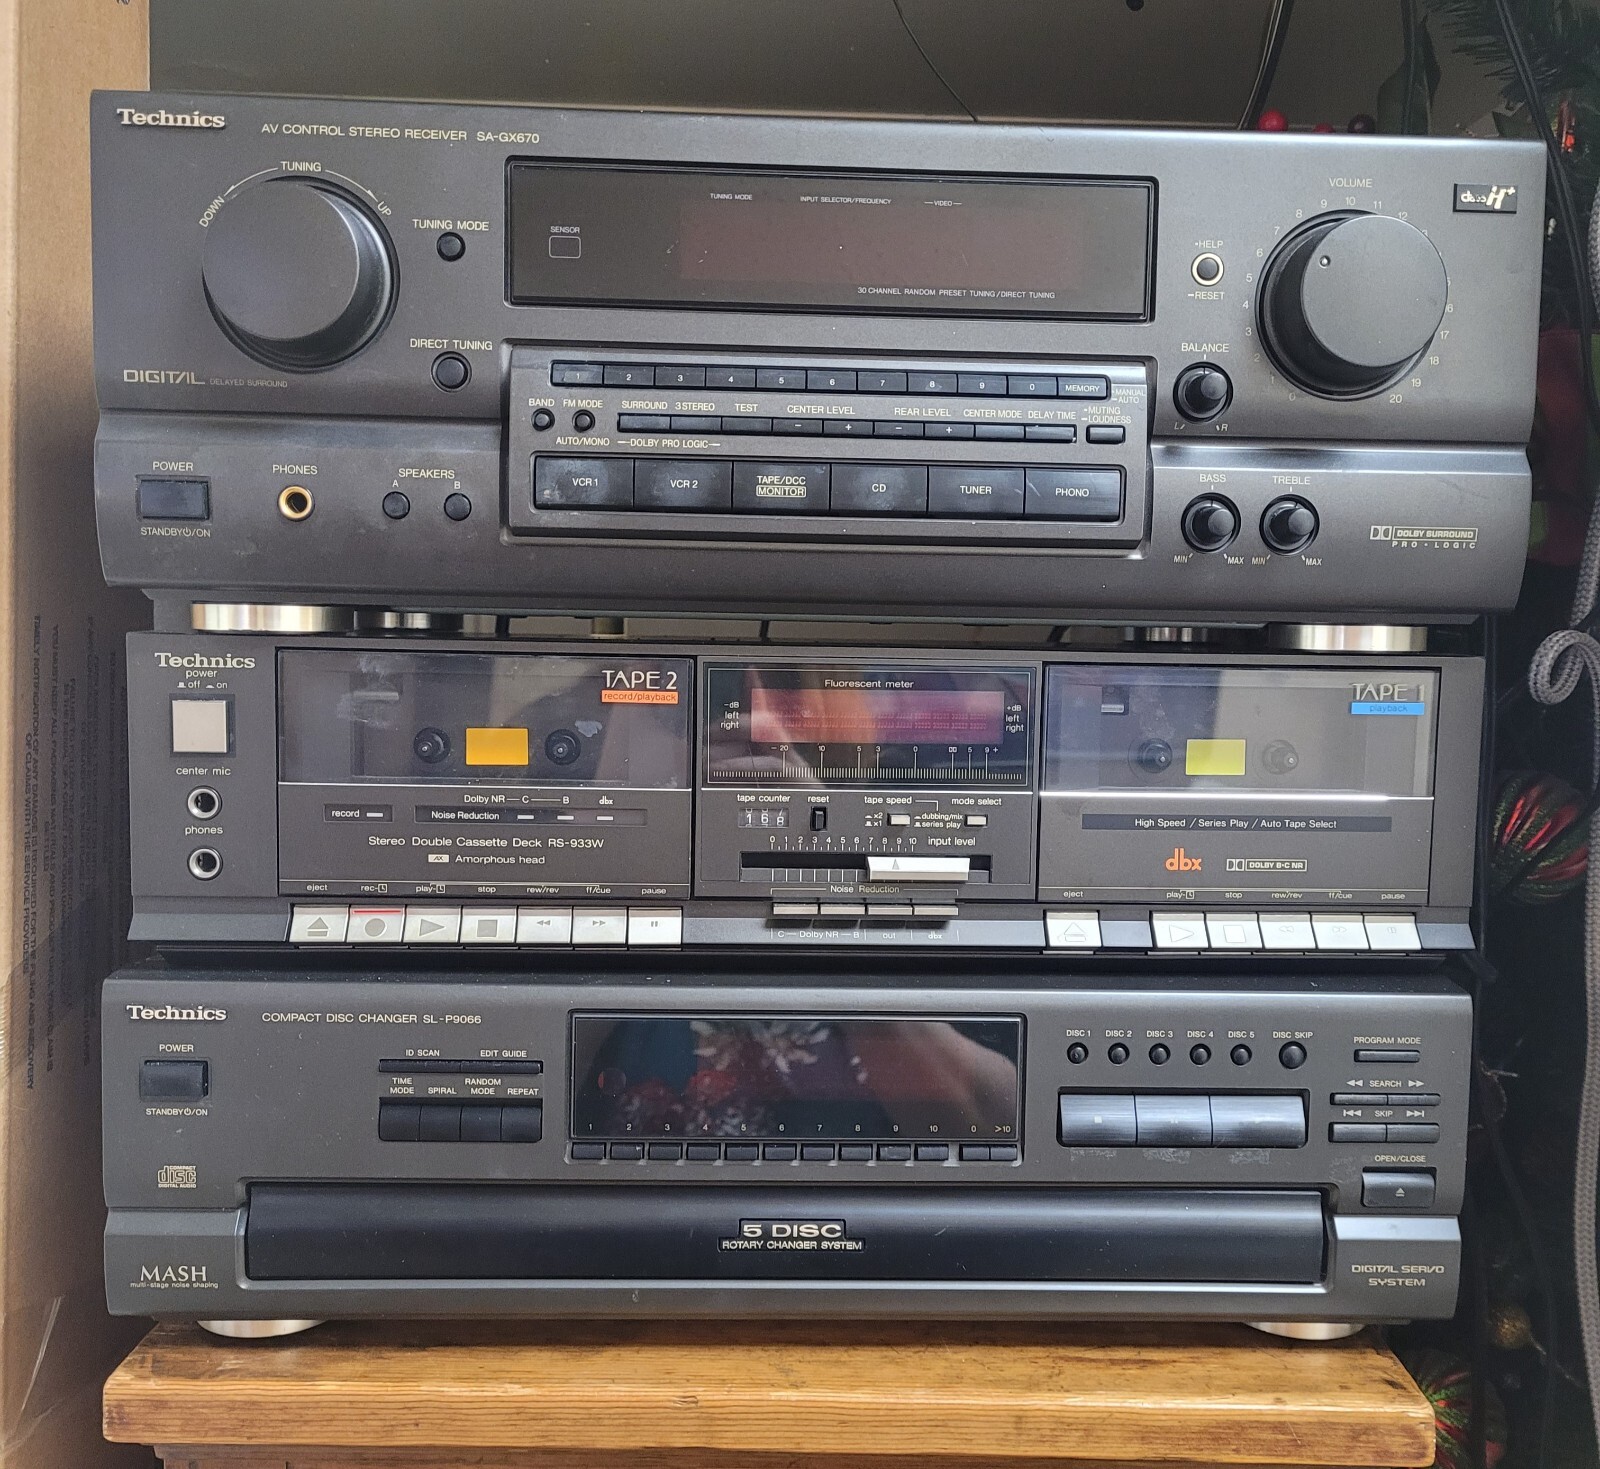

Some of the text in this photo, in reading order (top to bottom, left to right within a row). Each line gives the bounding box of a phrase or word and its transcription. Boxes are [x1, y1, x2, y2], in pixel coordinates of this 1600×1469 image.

[117, 108, 226, 129] Technics
[261, 123, 539, 144] AV CONTROL STEREO RECEIVER SA-GX670
[280, 161, 322, 172] TUNING
[1329, 178, 1372, 188] VOLUME
[821, 196, 892, 204] SELECTOR/FREQUENCY
[199, 197, 225, 228] DOWN
[376, 201, 392, 217] UP
[412, 219, 489, 231] TUNING MODE
[1198, 240, 1223, 248] HELP
[868, 287, 1055, 299] CHANNEL RANDOM PRESET TUNING
[1195, 292, 1225, 300] RESET
[410, 338, 493, 351] DIRECT TUNING
[1181, 343, 1230, 353] BALANCE
[124, 369, 205, 385] DIGITAL
[1065, 384, 1100, 393] MEMORY
[529, 398, 555, 407] BAND
[563, 399, 603, 408] FM MODE
[621, 400, 668, 410] SURROUND
[735, 404, 758, 412] TEST
[787, 405, 856, 415] CENTER LEVEL
[1088, 406, 1121, 415] MUTING
[963, 409, 1023, 419] CENTER MODE
[1028, 410, 1076, 420] DELAY TIME
[1088, 415, 1131, 424] LOUDNESS
[556, 437, 610, 446] AUTO/MONO
[630, 439, 708, 449] DOLBY PRO LOGIC
[152, 461, 194, 471] POWER
[272, 464, 318, 475] PHONES
[398, 468, 455, 479] SPEAKERS
[572, 478, 598, 487] VCR 1
[757, 476, 806, 485] TAPE/DCC
[1200, 474, 1226, 483] BASS
[1272, 476, 1311, 485] TREBLE
[670, 479, 698, 489] VCR 2
[872, 483, 886, 493] CD
[758, 487, 804, 496] MONITOR
[960, 485, 992, 495] TUNER
[1055, 488, 1089, 497] PHONO
[154, 652, 255, 669] Technics
[185, 669, 218, 679] power
[602, 670, 677, 690] TAPE 2
[824, 679, 914, 688] Fluorescent meter
[1352, 683, 1425, 701] TAPE 1
[604, 692, 676, 702] record/playback
[1369, 704, 1409, 714] playback
[725, 711, 739, 719] left
[720, 721, 739, 730] right
[176, 766, 231, 775] center mic
[464, 794, 505, 804] Dolby NR
[737, 794, 791, 802] tape counter
[808, 795, 830, 803] reset
[864, 796, 912, 805] tape speed
[951, 797, 1002, 806] mode select
[331, 808, 360, 818] record
[431, 811, 499, 820] Noise Reduction
[921, 812, 964, 821] dubbing/mix
[1135, 818, 1337, 829] High Speed Series Play Auto Tape Select
[185, 825, 223, 836] phones
[368, 836, 604, 848] Stereo Double Cassette Deck RS-933W
[928, 837, 976, 846] input level
[455, 855, 545, 864] Amorphous head
[1165, 847, 1202, 872] dbx
[306, 883, 328, 892] eject
[477, 886, 496, 894] stop
[526, 886, 559, 894] rew/rev
[585, 886, 611, 894] ff/cue
[641, 887, 667, 895] pause
[127, 1004, 227, 1021] Technics
[262, 1013, 481, 1024] COMPACT DISC CHANGER SL-P9066
[1273, 1031, 1313, 1039] DISC SKIP
[1397, 1037, 1421, 1045] MODE
[159, 1044, 194, 1053] POWER
[405, 1049, 440, 1057] ID SCAN
[392, 1077, 413, 1085] TIME
[464, 1078, 501, 1086] RANDOM
[1369, 1080, 1402, 1088] SEARCH
[428, 1087, 457, 1095] SPIRAL
[470, 1087, 495, 1095] MODE
[507, 1087, 539, 1095] REPEAT
[1375, 1155, 1426, 1163] OPEN/CLOSE
[743, 1225, 841, 1238] 5 DISC
[722, 1241, 862, 1251] ROTARY CHANGER SYSTEM
[140, 1266, 206, 1281] MASH
[1352, 1265, 1445, 1274] DIGITAL SERVO
[1368, 1278, 1426, 1286] SYSTEM
